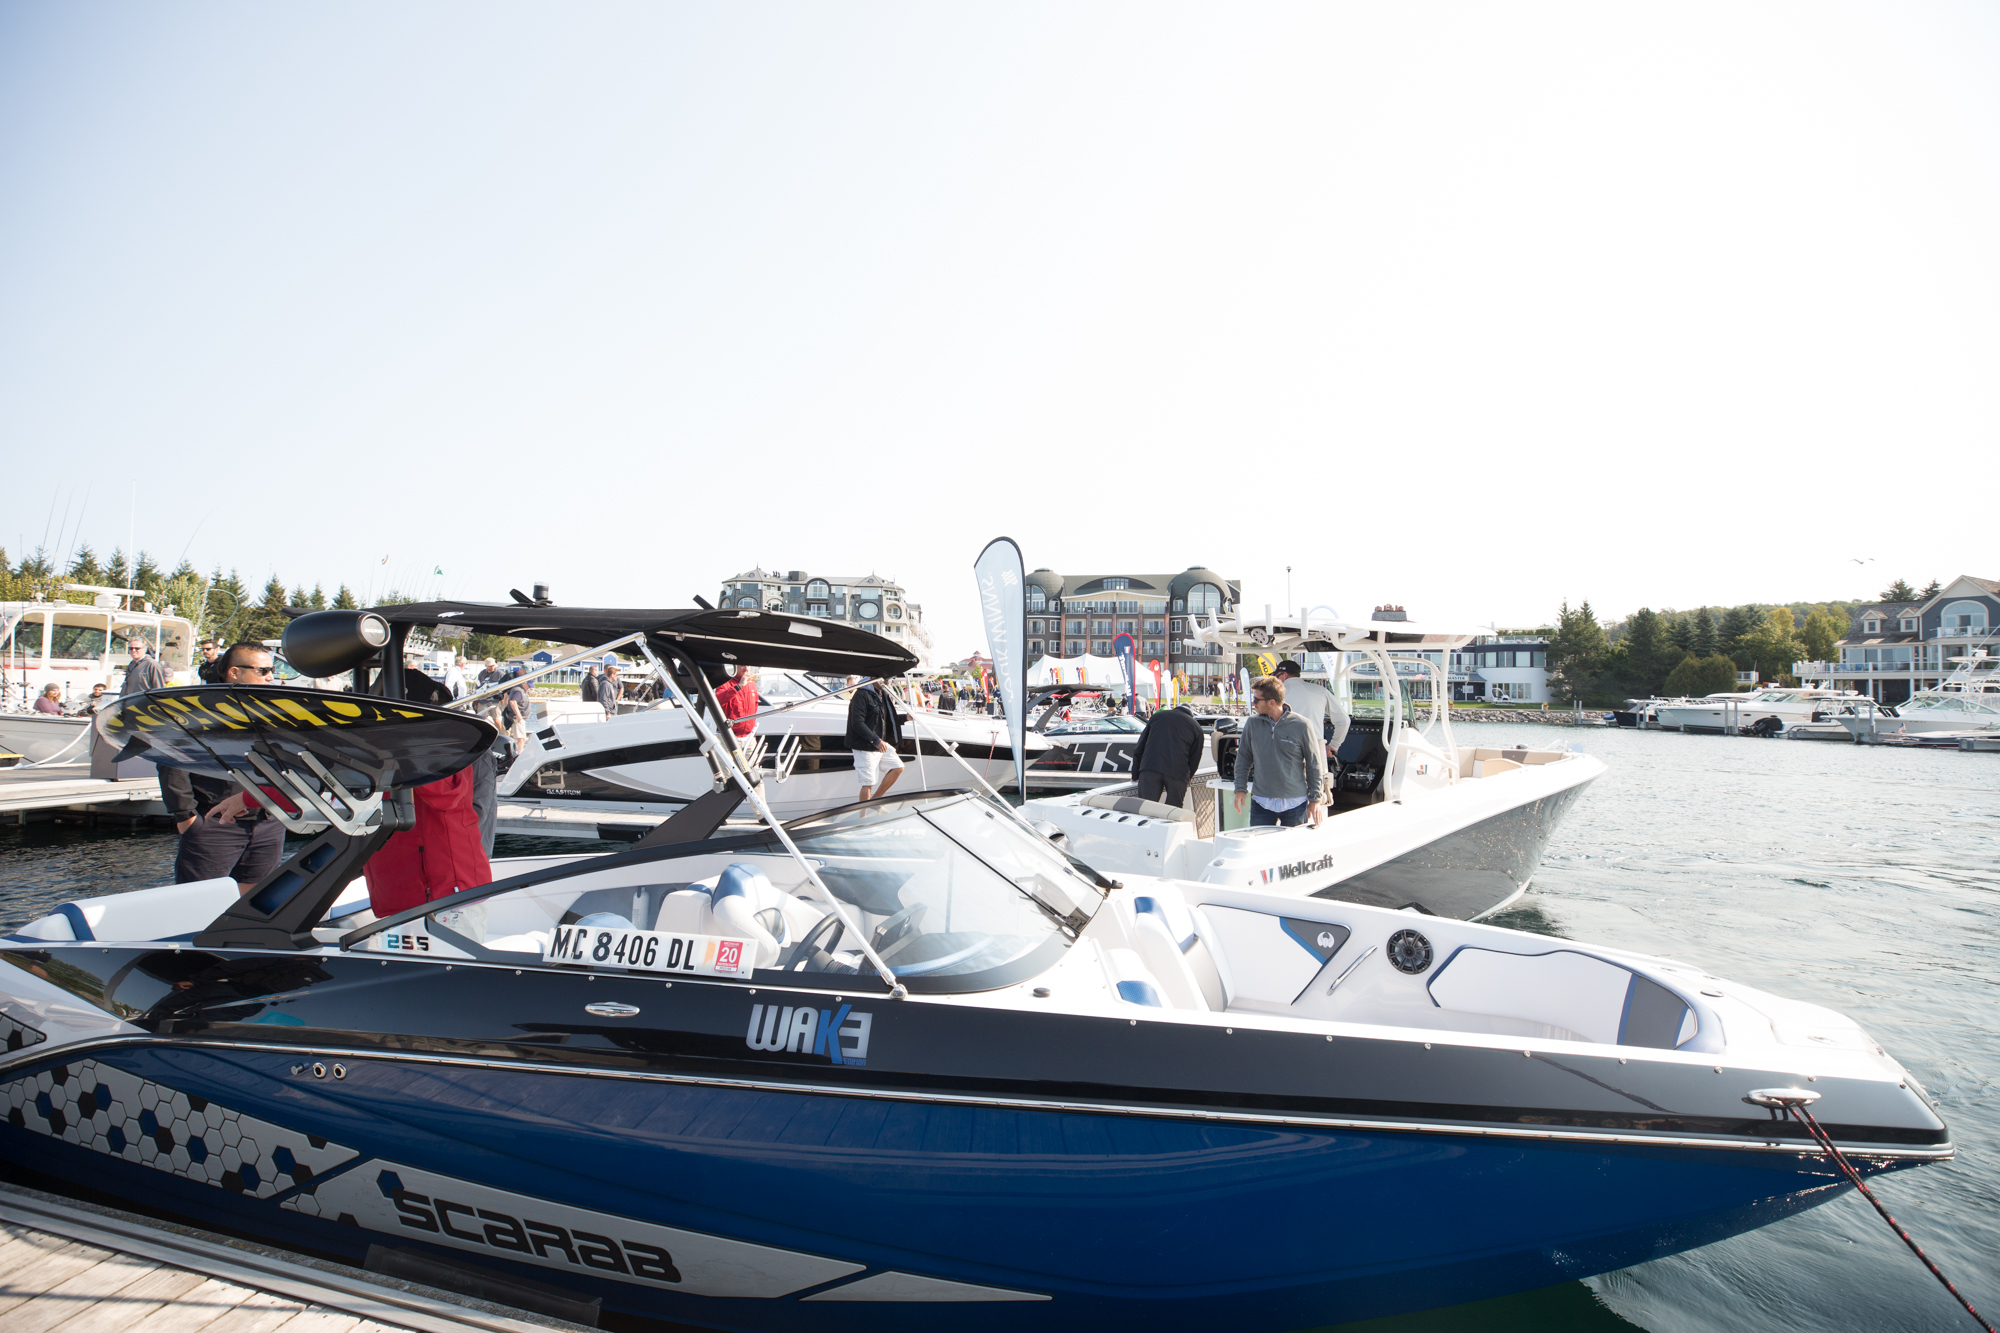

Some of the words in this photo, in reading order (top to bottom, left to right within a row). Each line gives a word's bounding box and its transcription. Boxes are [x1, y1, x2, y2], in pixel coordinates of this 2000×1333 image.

[1278, 854, 1333, 881] Wellcraft
[387, 934, 429, 951] 255
[550, 928, 587, 960] MC
[592, 932, 659, 967] 8406
[666, 938, 695, 971] DL
[719, 947, 738, 963] 20
